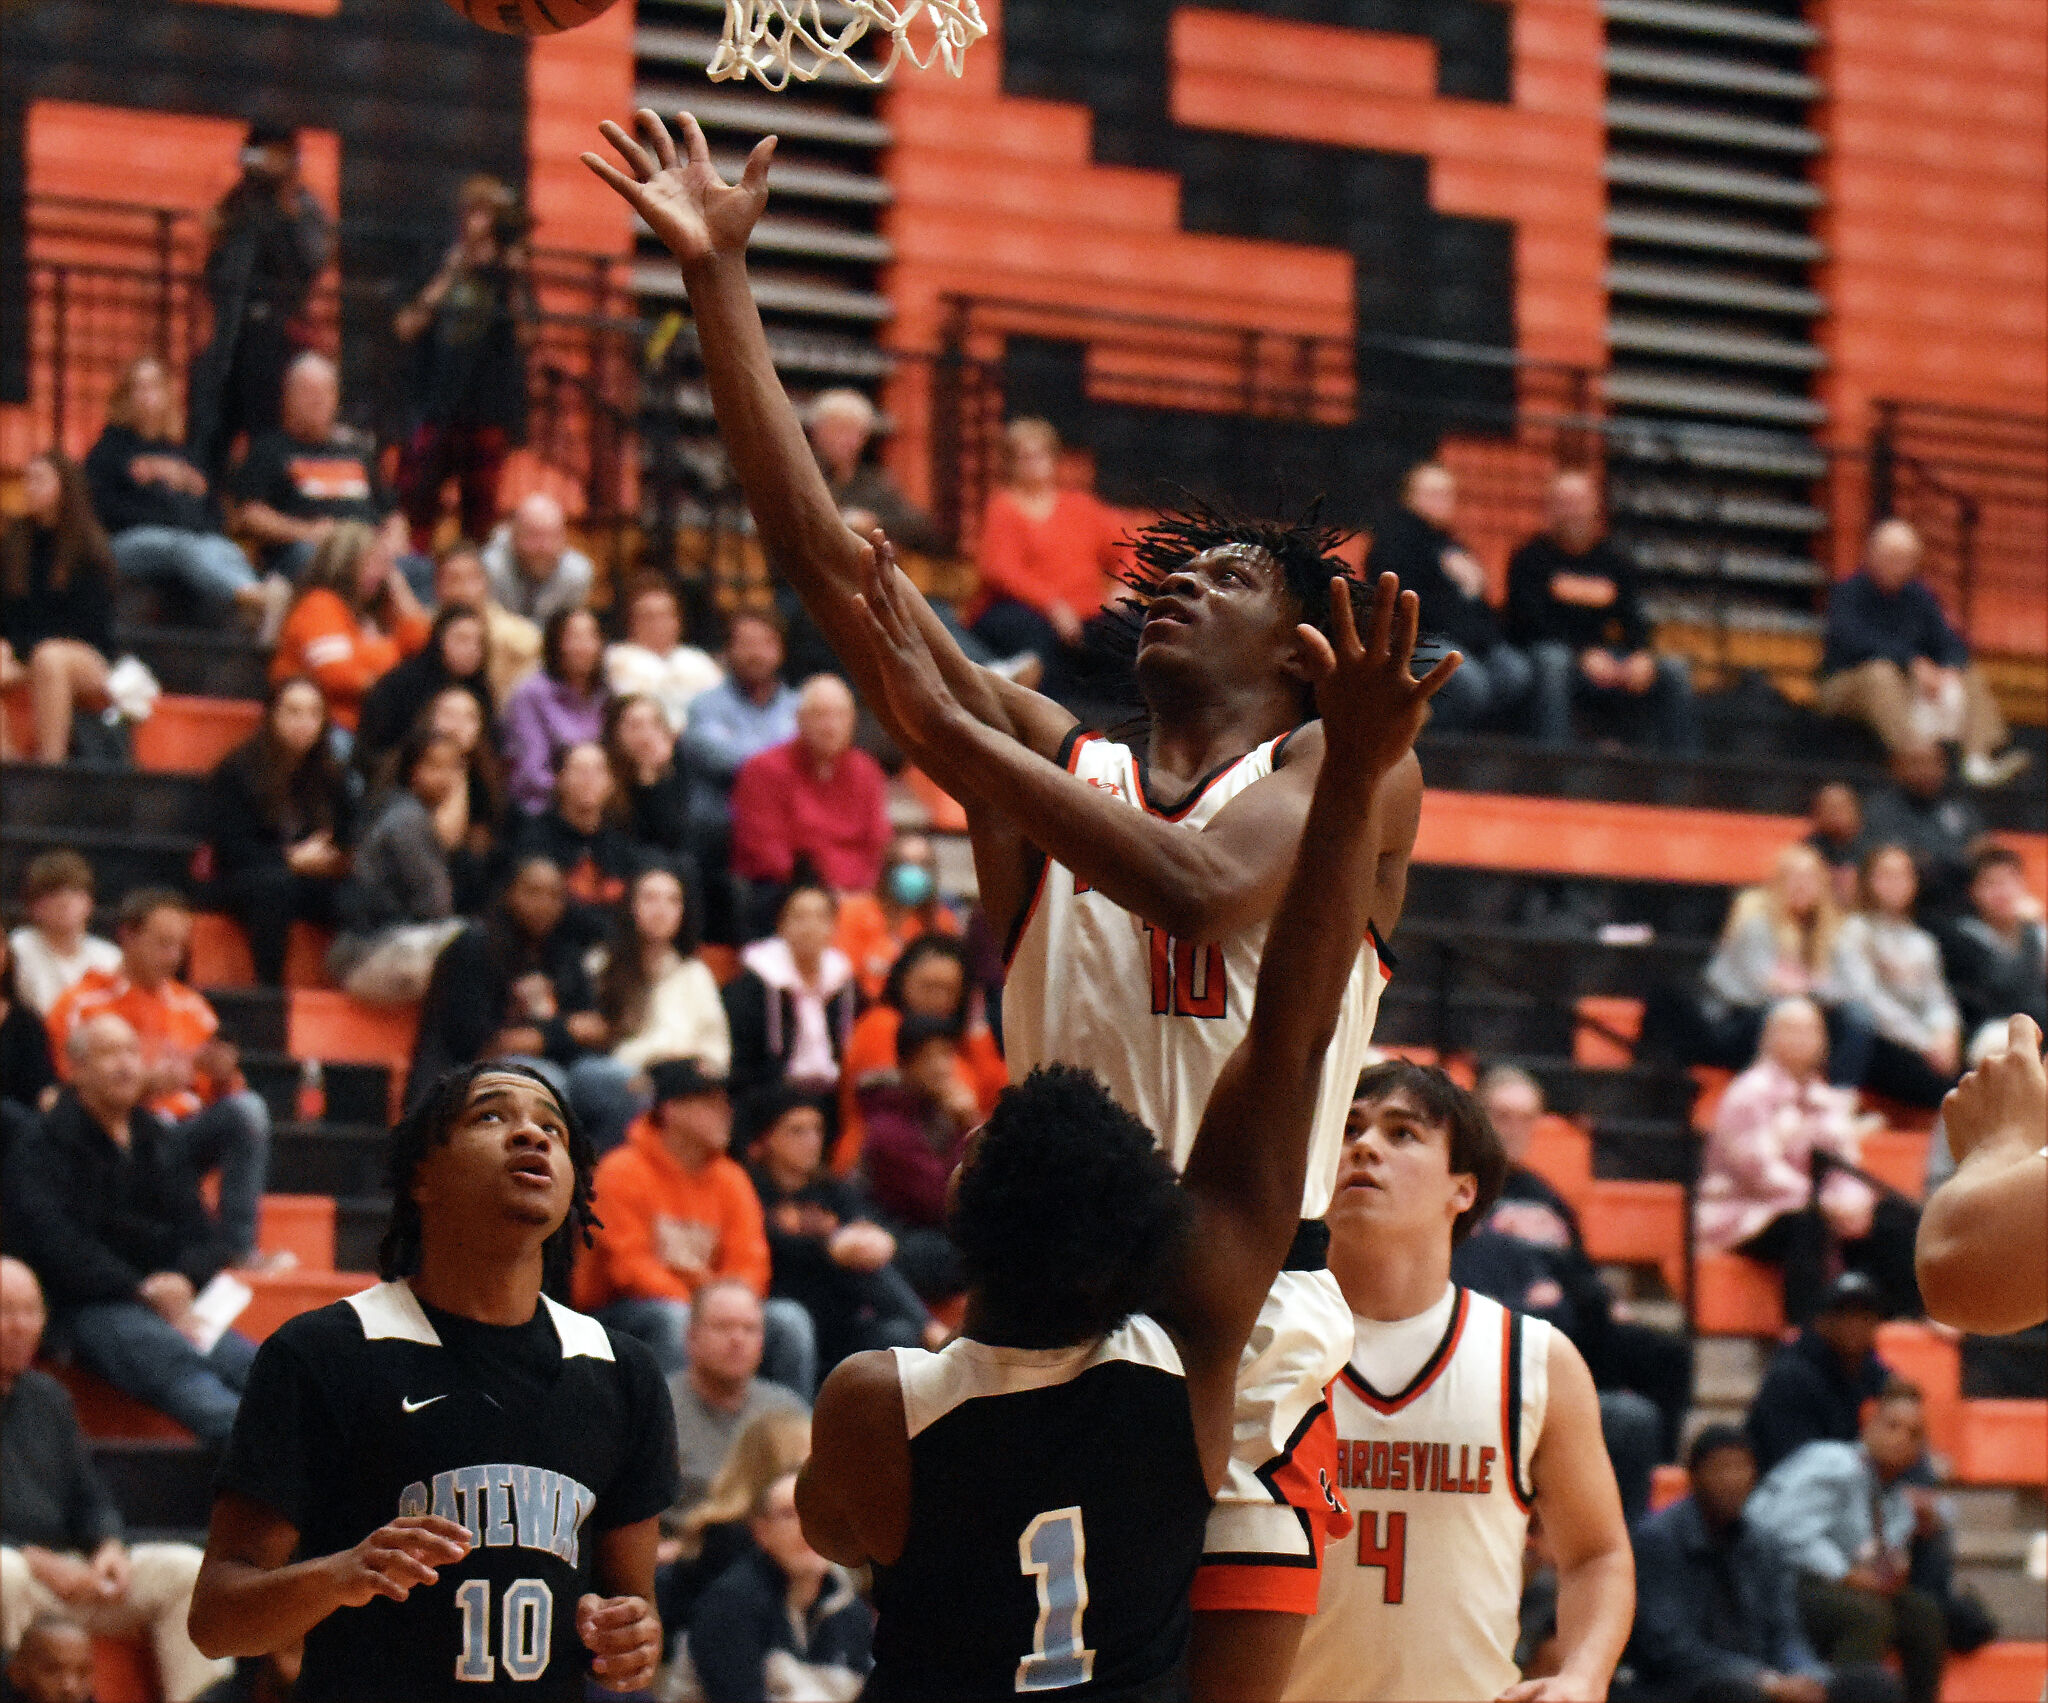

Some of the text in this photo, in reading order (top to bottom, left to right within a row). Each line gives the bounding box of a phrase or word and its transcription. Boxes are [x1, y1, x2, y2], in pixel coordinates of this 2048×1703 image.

[1144, 922, 1228, 1019] 10
[1015, 1505, 1097, 1693] 1
[1357, 1510, 1407, 1604] 4
[455, 1578, 553, 1682] 10
